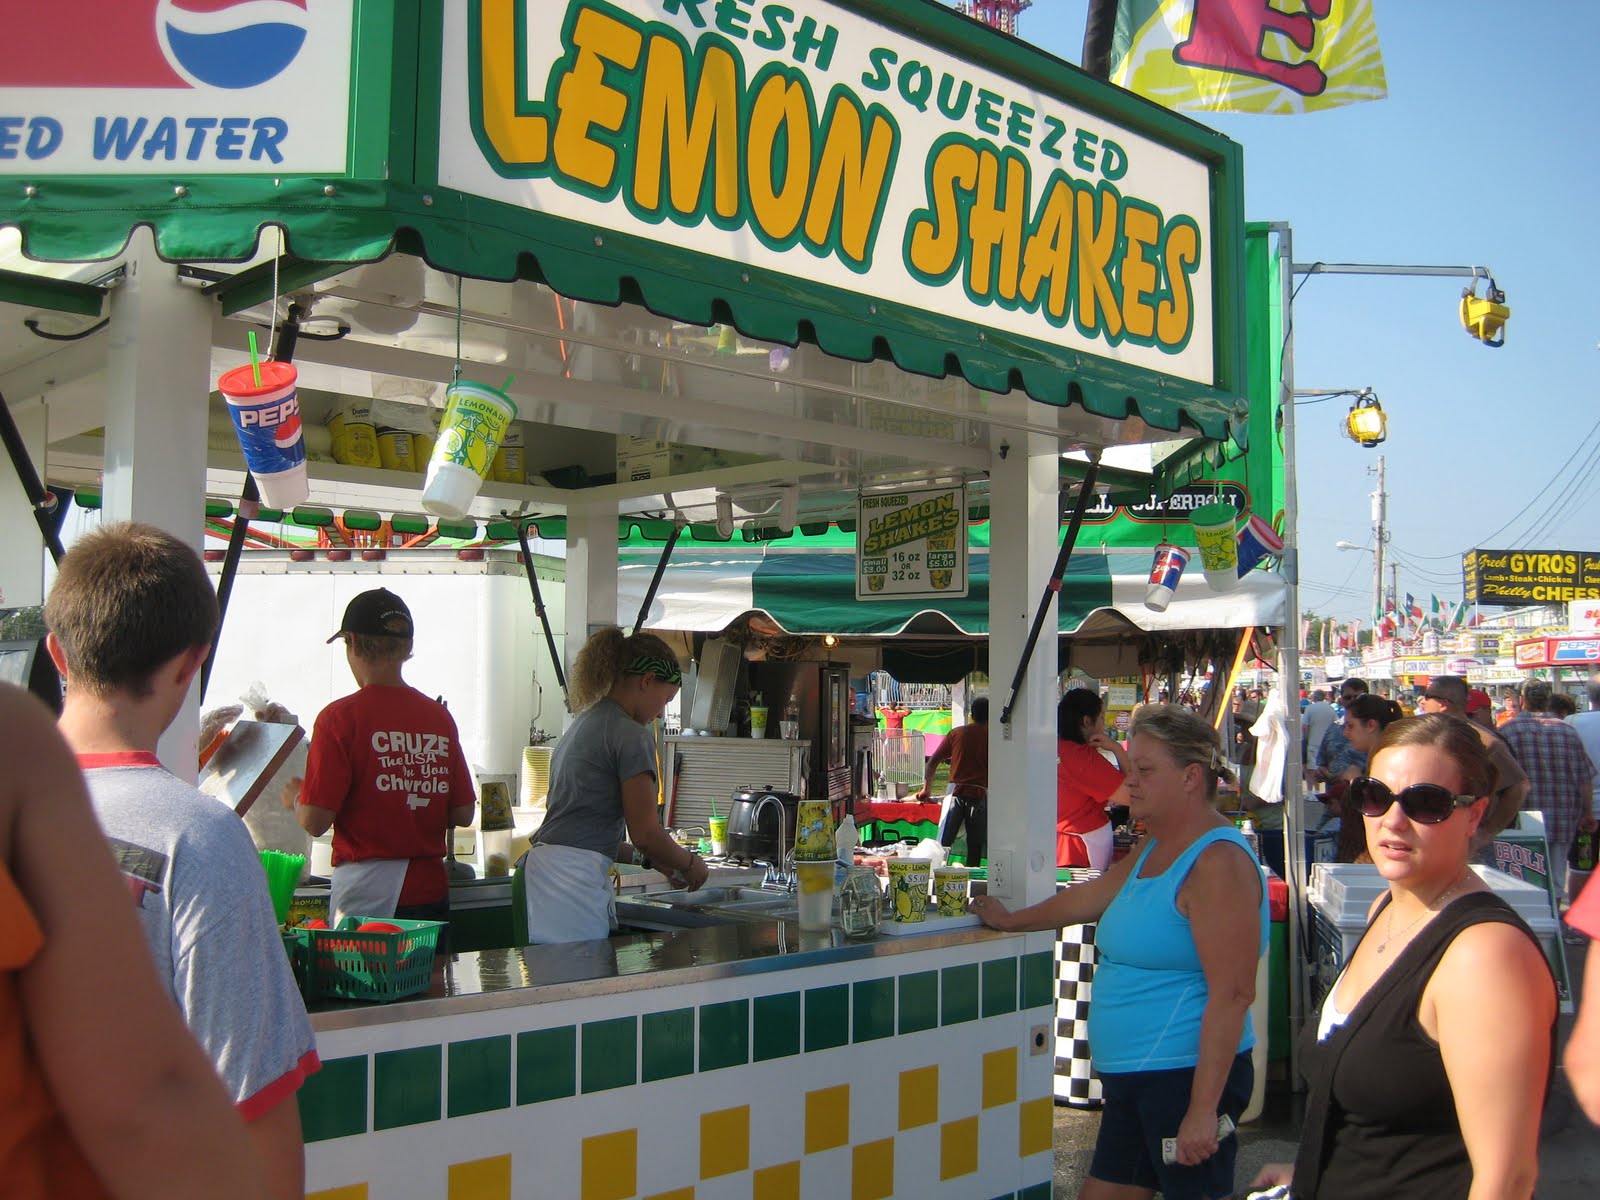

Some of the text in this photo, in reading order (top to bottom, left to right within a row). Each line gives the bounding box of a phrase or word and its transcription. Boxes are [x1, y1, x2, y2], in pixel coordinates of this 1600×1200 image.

[861, 48, 1128, 181] SQUEEZED
[93, 116, 289, 164] WATER
[470, 0, 1200, 353] LEMON SHAKES
[862, 495, 909, 509] FRESH SQUEEZED
[869, 492, 954, 534] LEMON
[864, 509, 959, 555] SHAKES
[863, 558, 887, 566] small
[892, 552, 920, 562] 16 oz
[928, 552, 955, 561] large
[1479, 553, 1508, 571] Greek
[1510, 554, 1576, 574] GYROS
[863, 566, 887, 574] $3.00
[928, 560, 955, 568] $5.00
[892, 571, 920, 581] 32 oz
[1484, 574, 1573, 584] Lamb Steak Chicken
[1482, 584, 1531, 599] Philly
[1558, 641, 1598, 649] PEPSI
[372, 731, 449, 757] CRUZE
[378, 749, 437, 768] The USA
[402, 765, 415, 777] In
